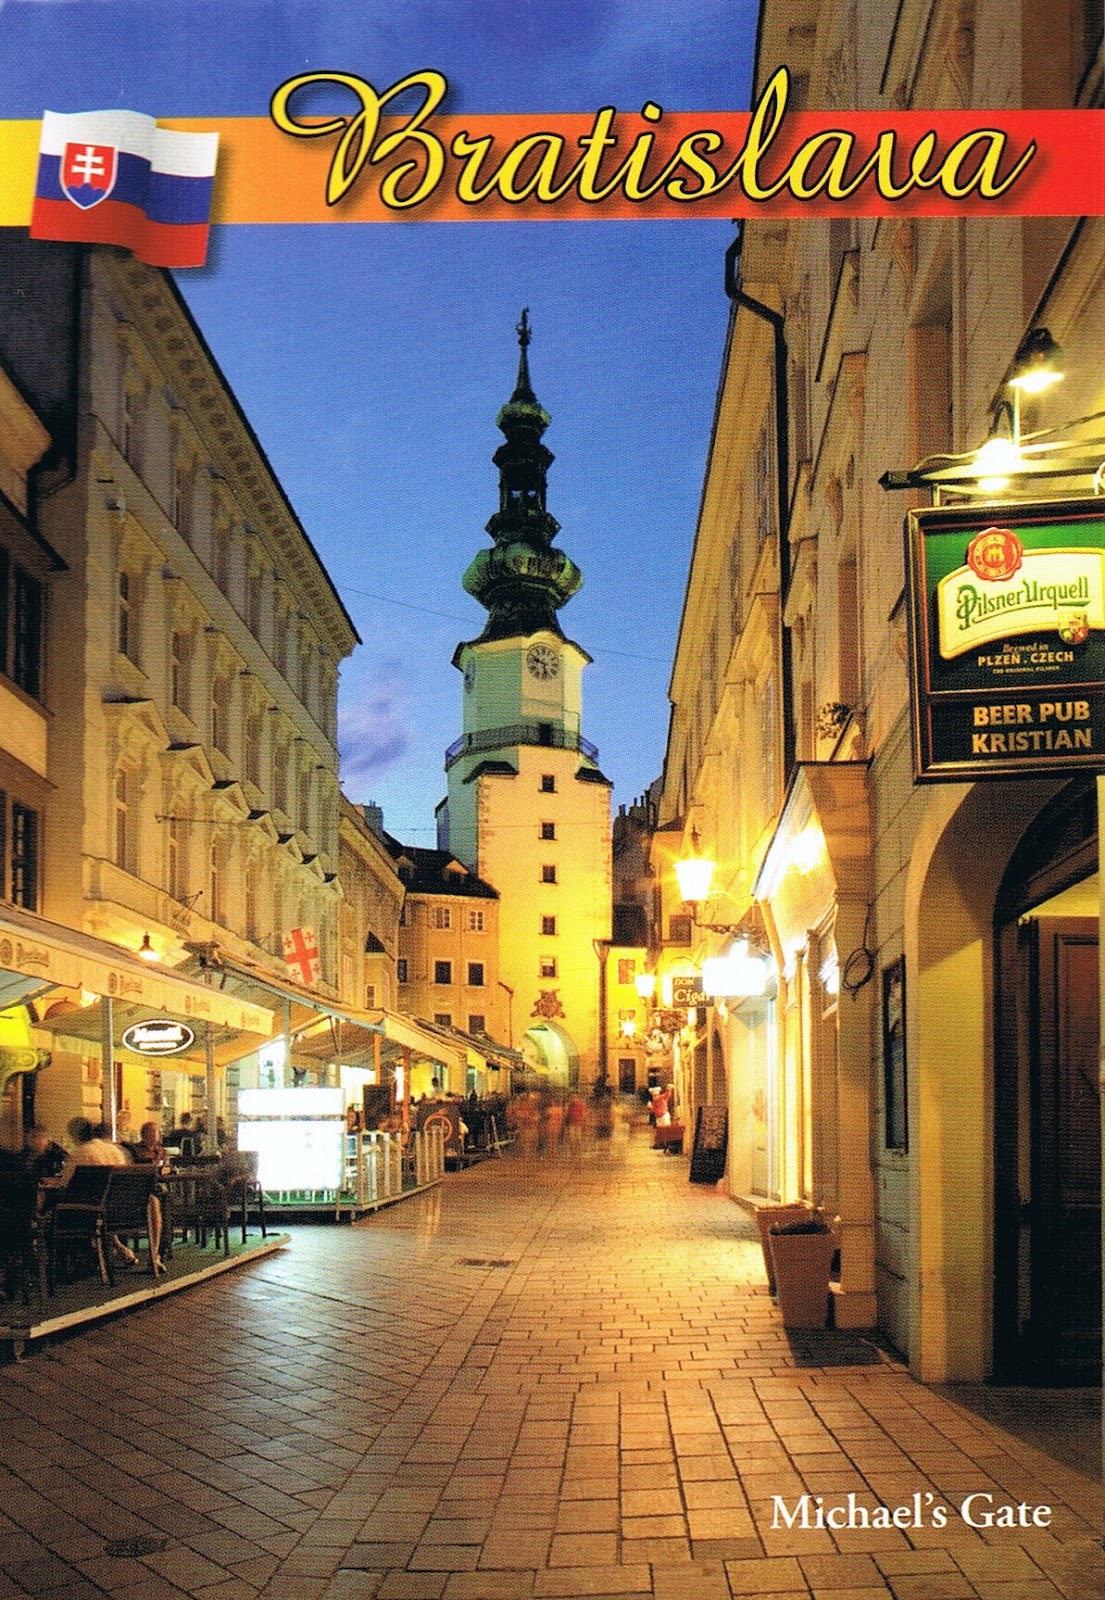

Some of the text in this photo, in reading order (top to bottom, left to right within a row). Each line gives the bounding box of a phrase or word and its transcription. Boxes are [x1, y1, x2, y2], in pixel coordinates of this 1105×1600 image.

[956, 576, 1089, 631] Pilsner Urquell
[1030, 651, 1074, 663] CZECH
[973, 700, 1090, 726] BEER PUB
[971, 728, 1093, 754] KRISTIAN
